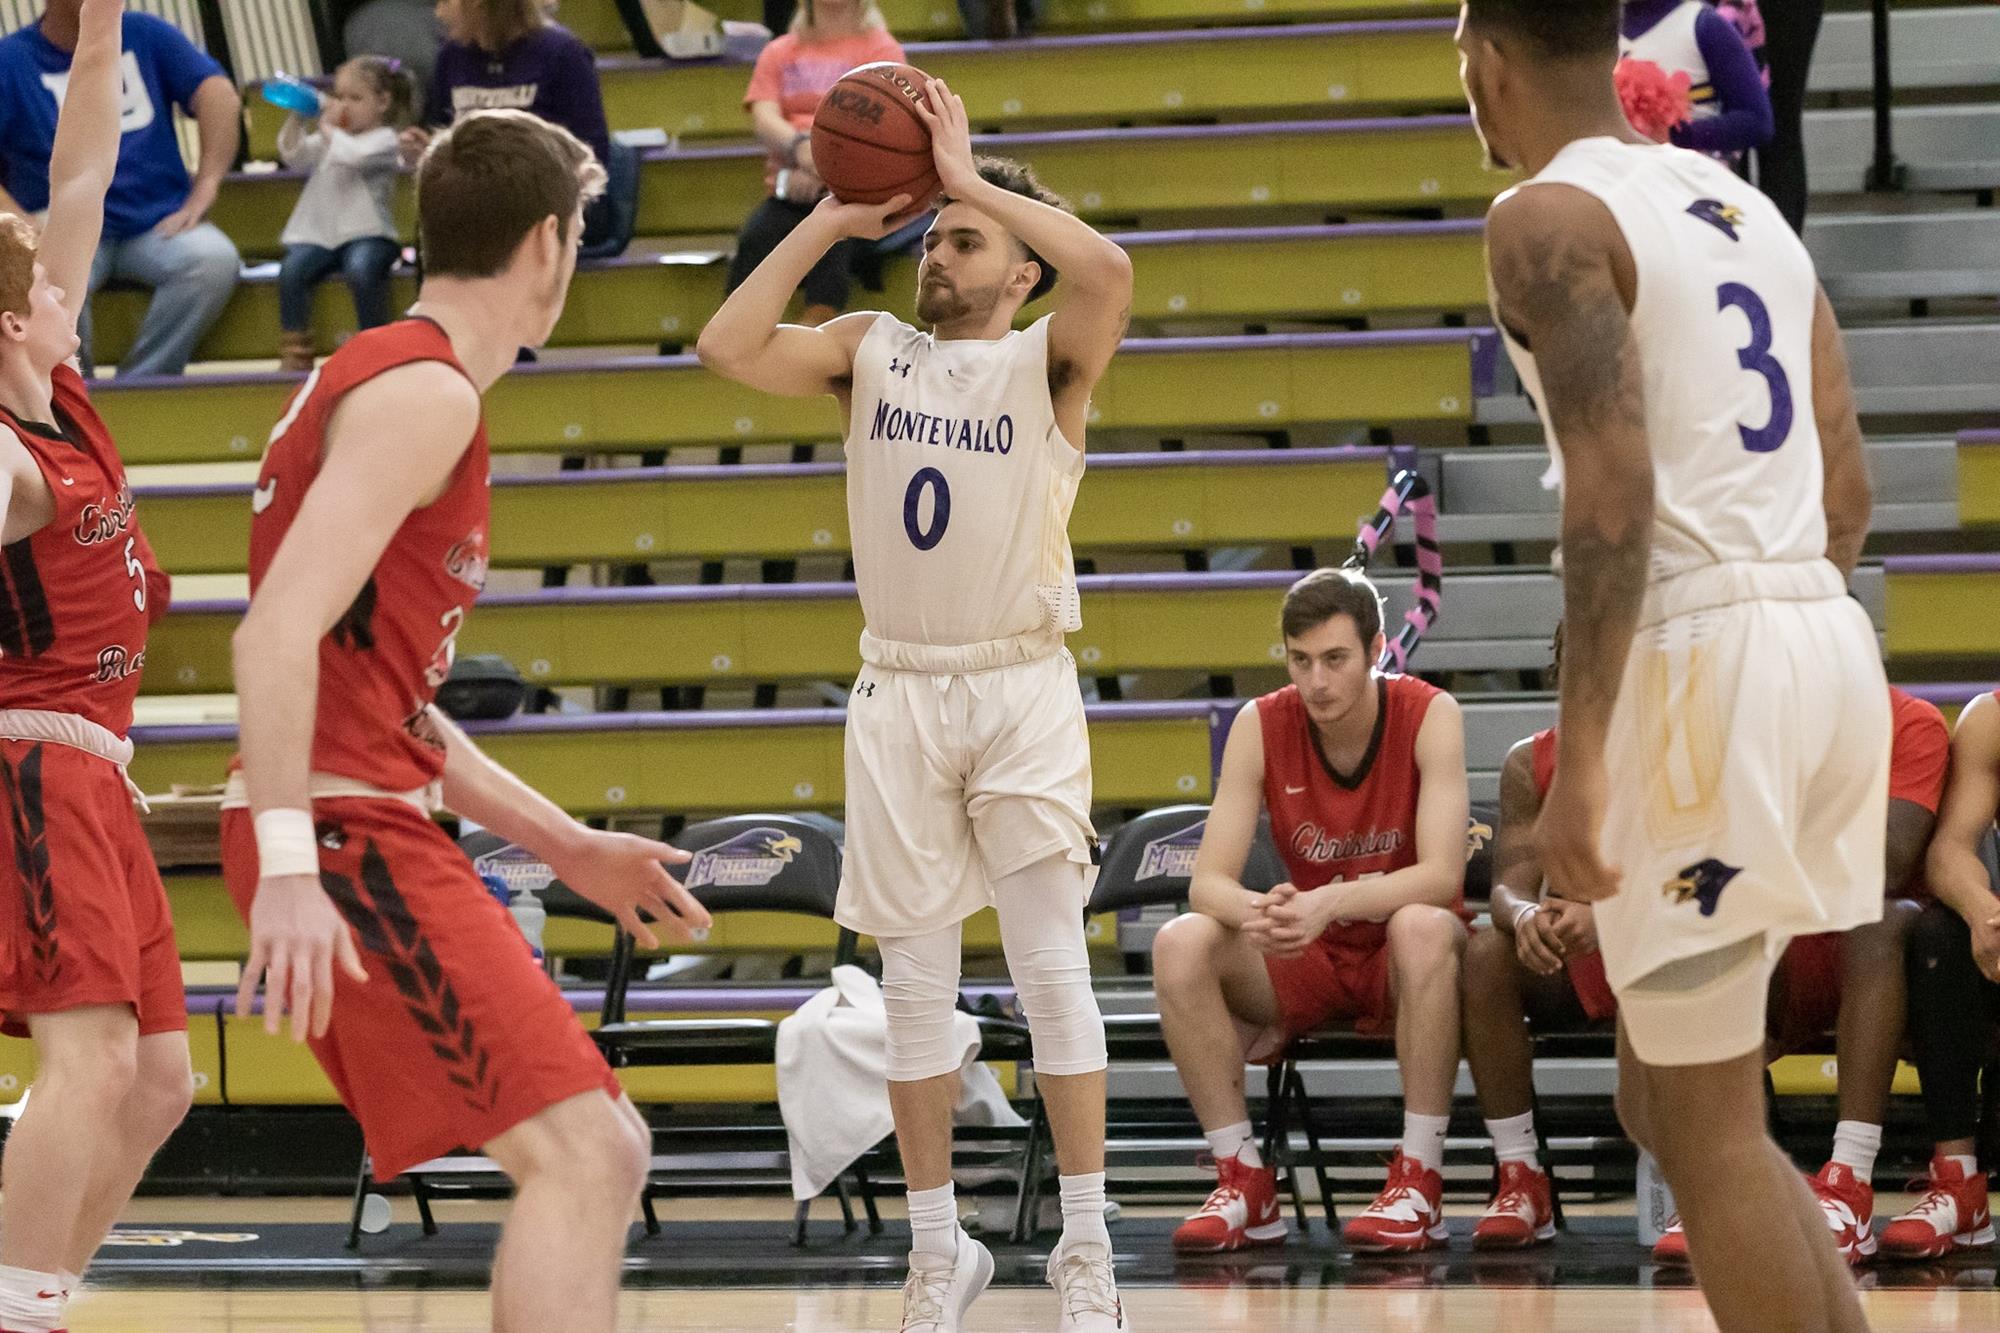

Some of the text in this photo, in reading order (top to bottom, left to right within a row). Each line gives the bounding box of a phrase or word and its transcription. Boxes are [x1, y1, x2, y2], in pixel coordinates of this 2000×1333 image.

[1717, 282, 1793, 452] 3
[869, 398, 1014, 455] MONTEVALLO
[903, 466, 951, 551] 0
[124, 536, 147, 613] 5
